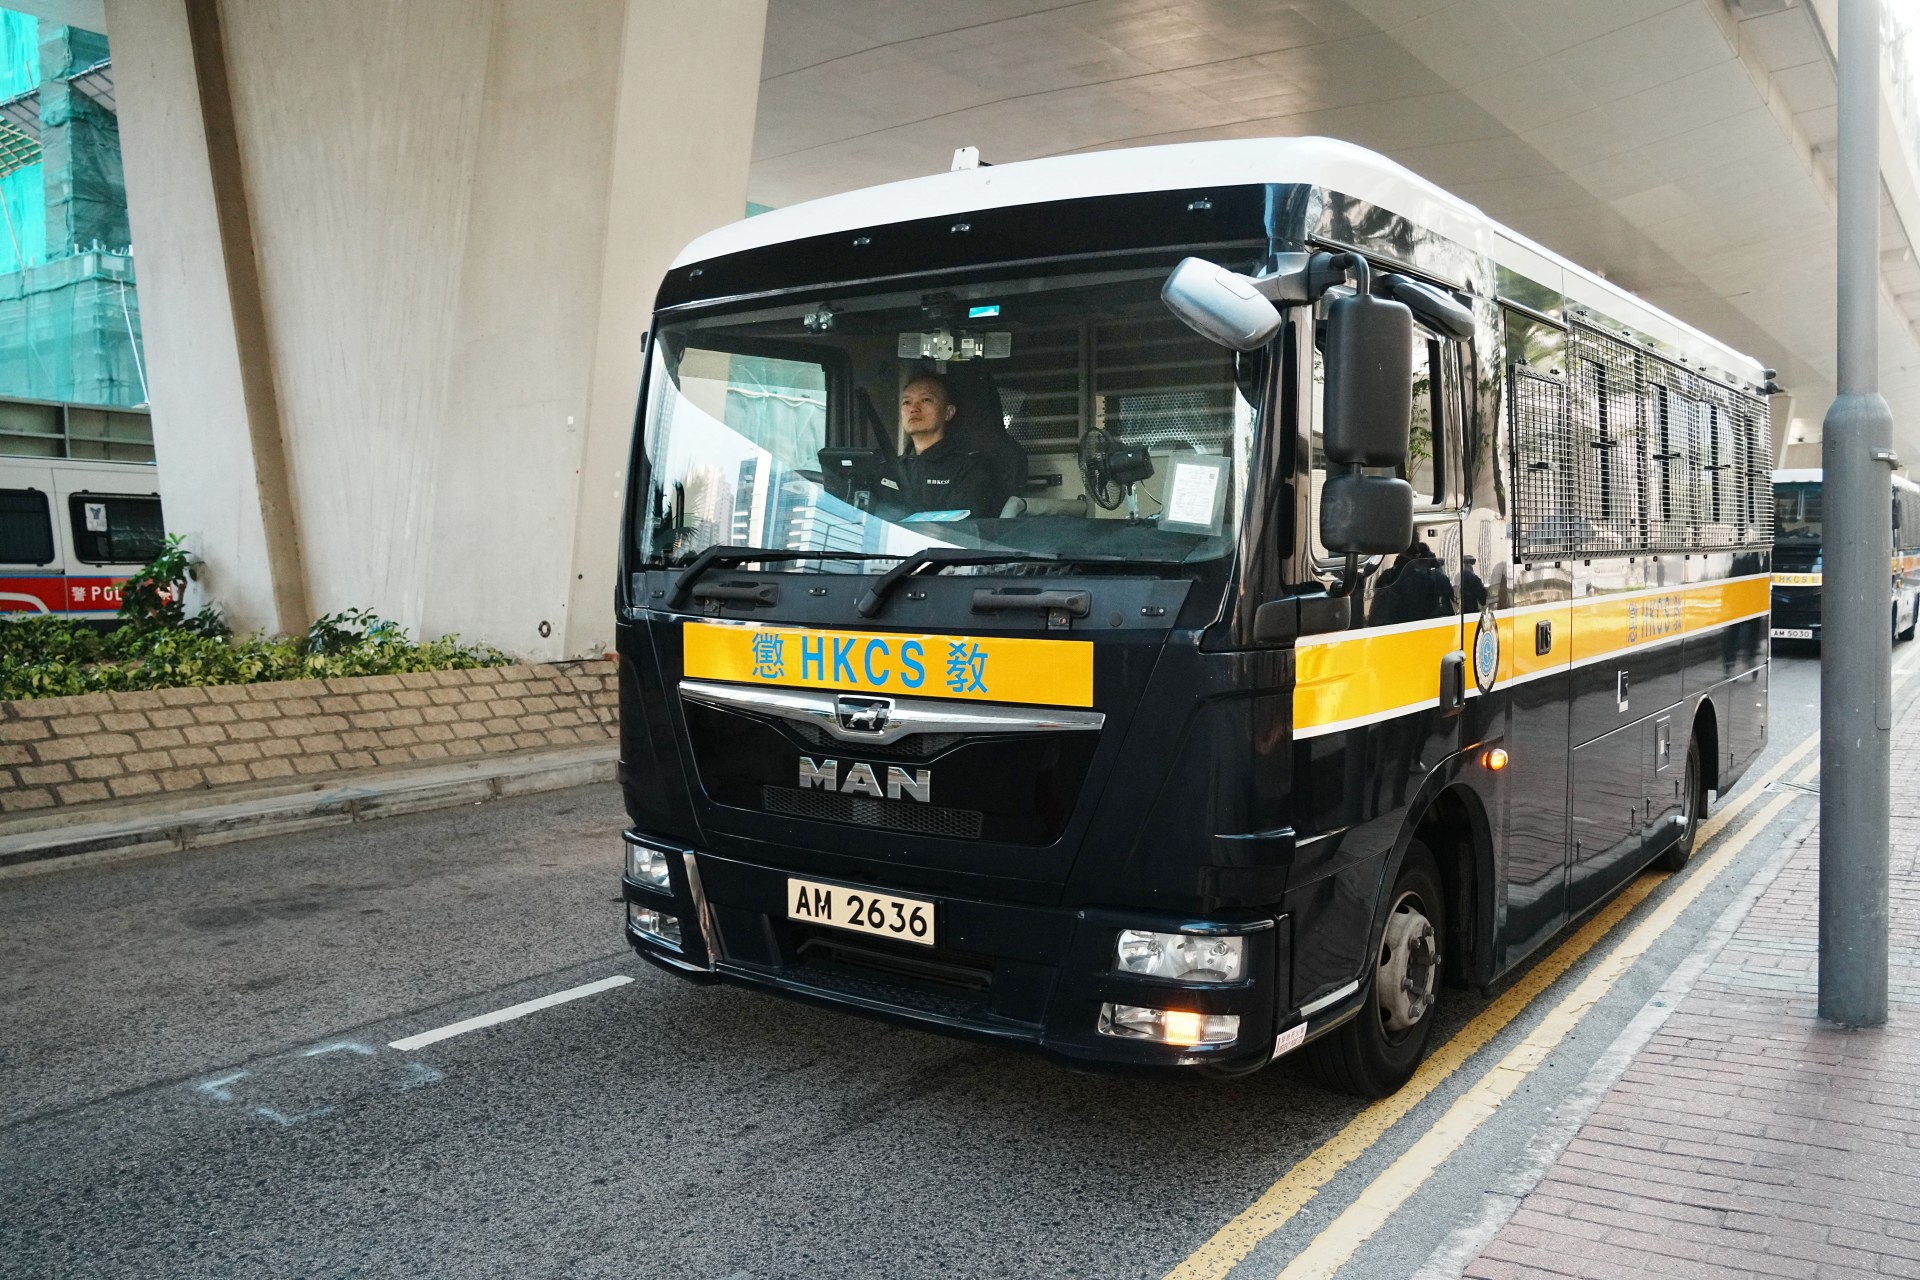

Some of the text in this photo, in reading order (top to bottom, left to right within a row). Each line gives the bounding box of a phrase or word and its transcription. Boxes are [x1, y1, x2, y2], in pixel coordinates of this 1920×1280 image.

[1779, 575, 1808, 584] HKCS
[1641, 596, 1670, 638] HKCS
[1787, 630, 1810, 638] 5030
[751, 632, 785, 680] 懲
[801, 636, 925, 689] HKCS
[799, 756, 931, 803] MAN
[795, 886, 928, 938] AM 2636
